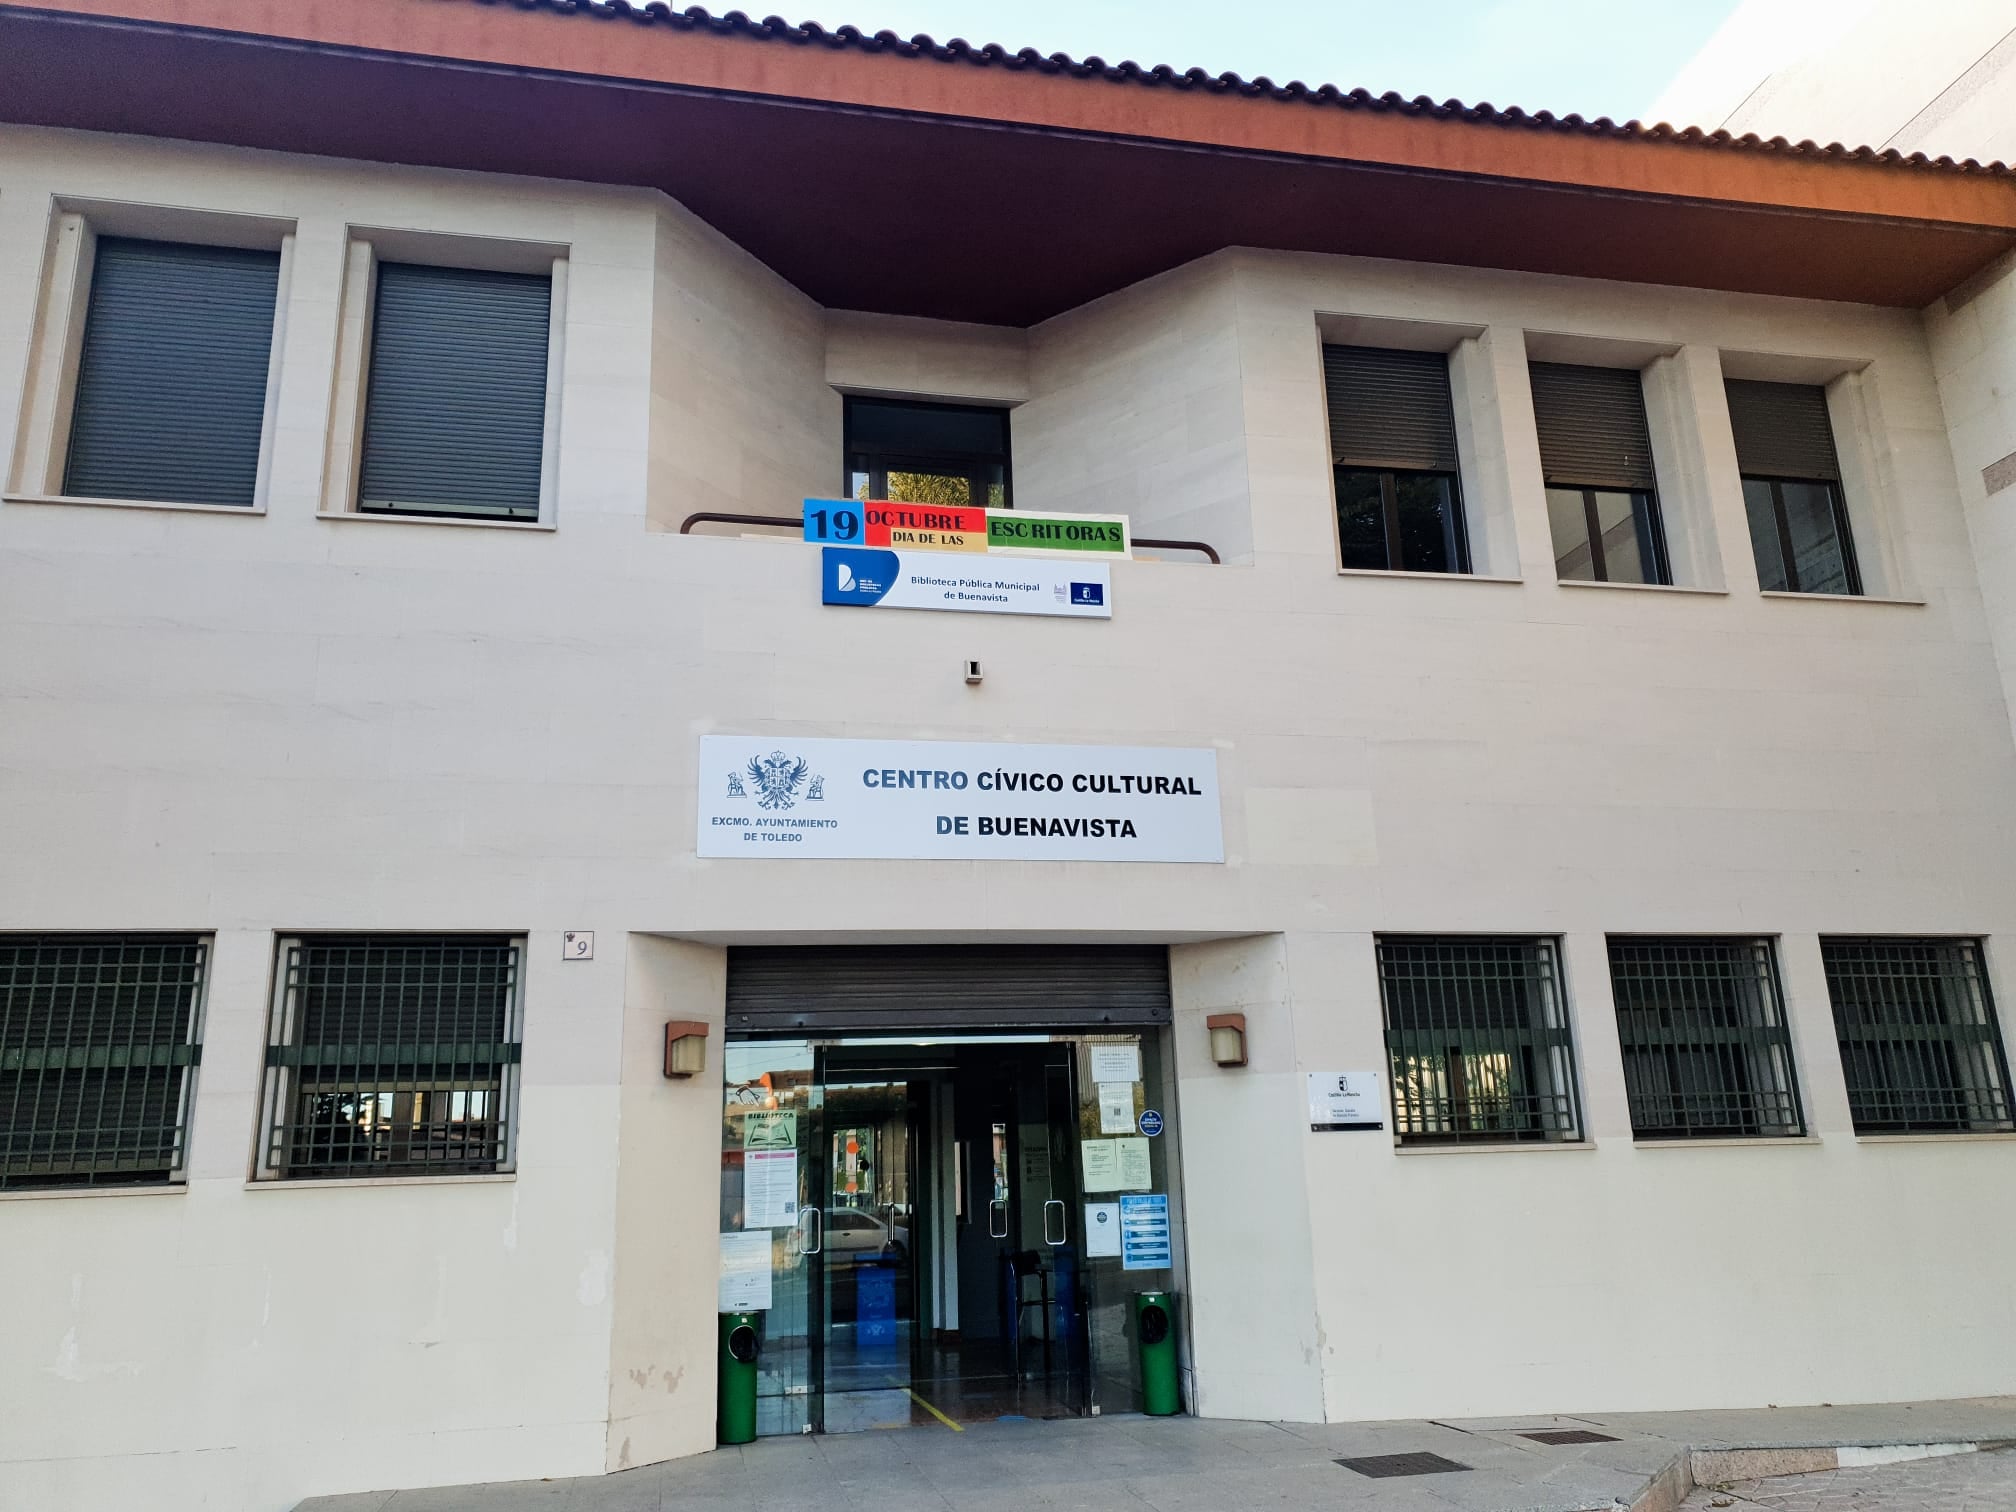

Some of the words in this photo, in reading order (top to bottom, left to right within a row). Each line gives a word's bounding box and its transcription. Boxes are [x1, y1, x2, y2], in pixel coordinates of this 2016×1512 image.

[810, 509, 859, 540] 19
[866, 510, 967, 530] OCTUBRE
[892, 531, 915, 543] DIA
[919, 533, 936, 544] DE
[941, 534, 964, 546] LAS
[991, 521, 1121, 542] ESCRITORAS
[911, 576, 957, 587] Biblioteca
[960, 579, 992, 589] Pública
[995, 581, 1040, 592] Municipal
[944, 591, 956, 600] de
[958, 592, 1008, 603] Buenavista
[862, 768, 969, 790] CENTRO
[977, 768, 1065, 793] CÍVICO
[1072, 774, 1202, 796] CULTURAL
[711, 817, 752, 827] EXCMO.
[755, 818, 838, 829] AYUNTAMIENTO
[936, 815, 969, 836] DE
[978, 816, 1138, 839] BUENAVISTA
[744, 832, 757, 841] DE
[761, 833, 803, 842] TOLEDO
[577, 940, 588, 956] 9
[748, 1112, 794, 1120] BIBLIOTECA
